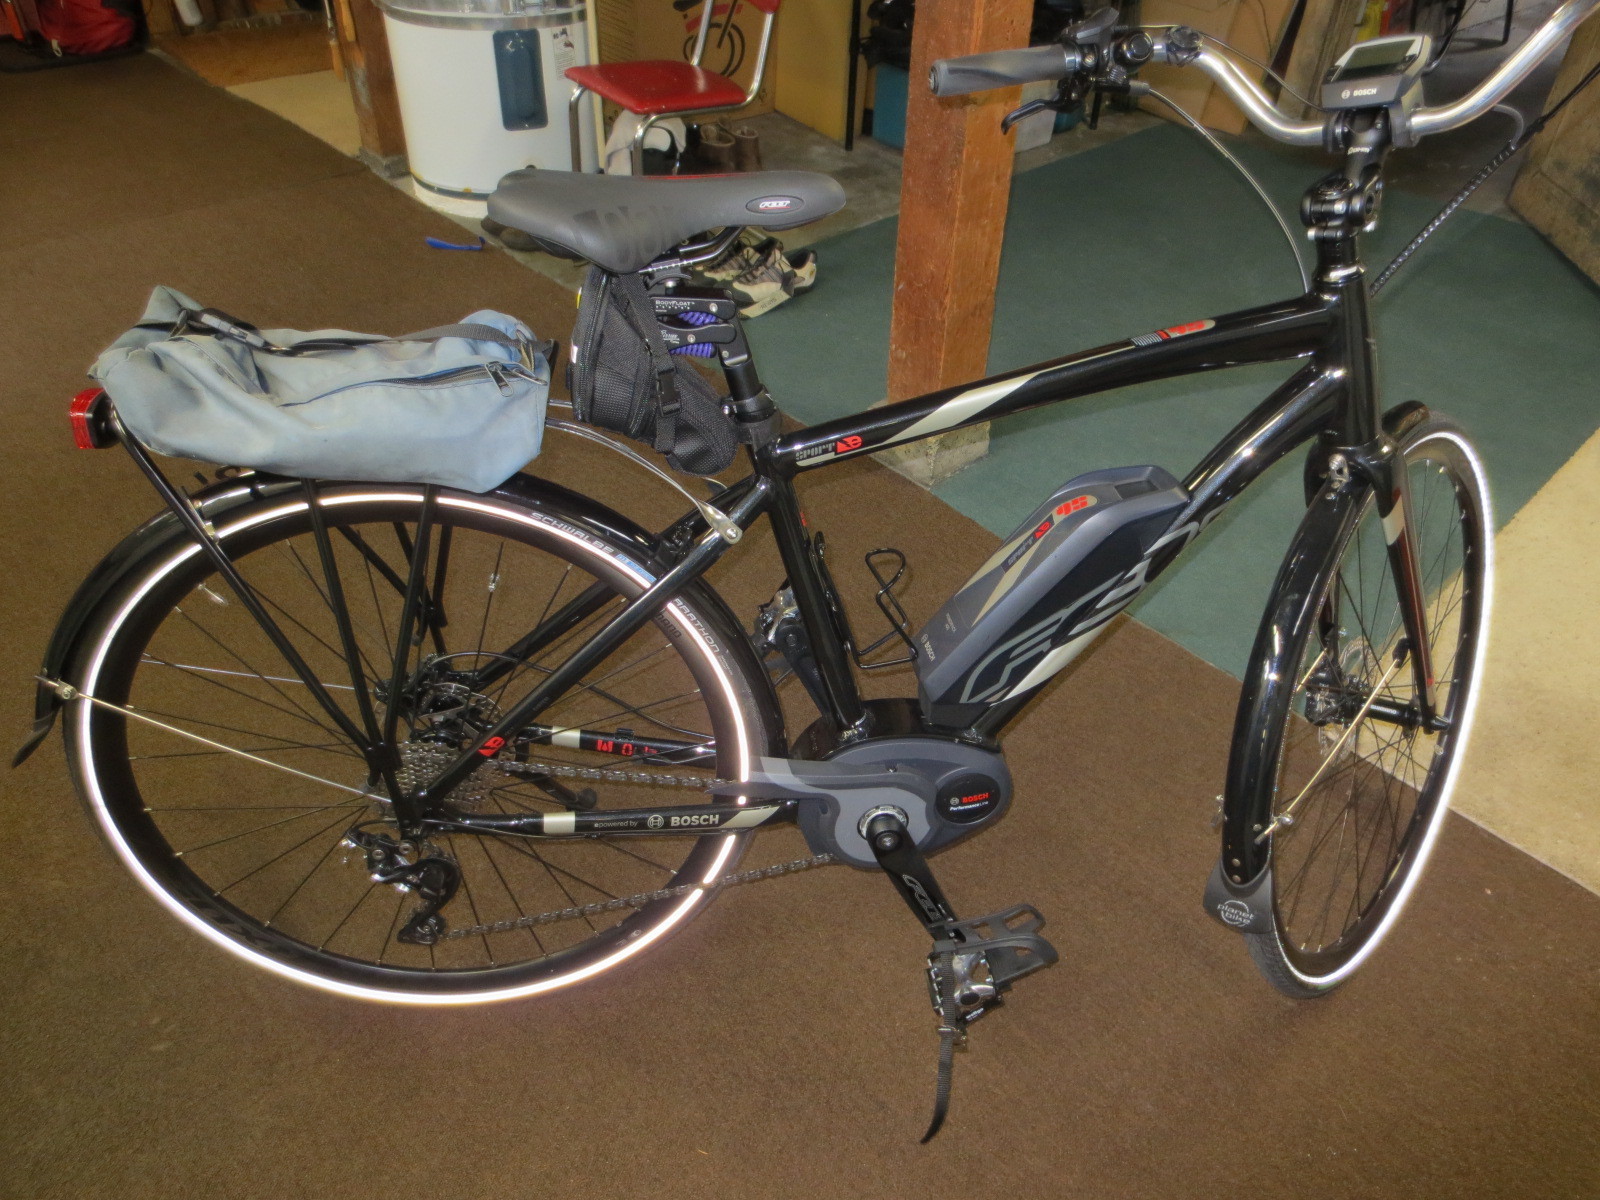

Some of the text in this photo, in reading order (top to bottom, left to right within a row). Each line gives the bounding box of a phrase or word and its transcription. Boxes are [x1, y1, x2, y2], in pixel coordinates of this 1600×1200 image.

[1353, 88, 1377, 97] BOSCH
[531, 512, 615, 554] SCHWALBE
[671, 597, 721, 654] ARATHON
[961, 792, 990, 804] BOSCH
[629, 819, 638, 828] by
[670, 814, 720, 827] BOSCH
[1217, 903, 1255, 920] planet
[1225, 911, 1251, 925] bike
